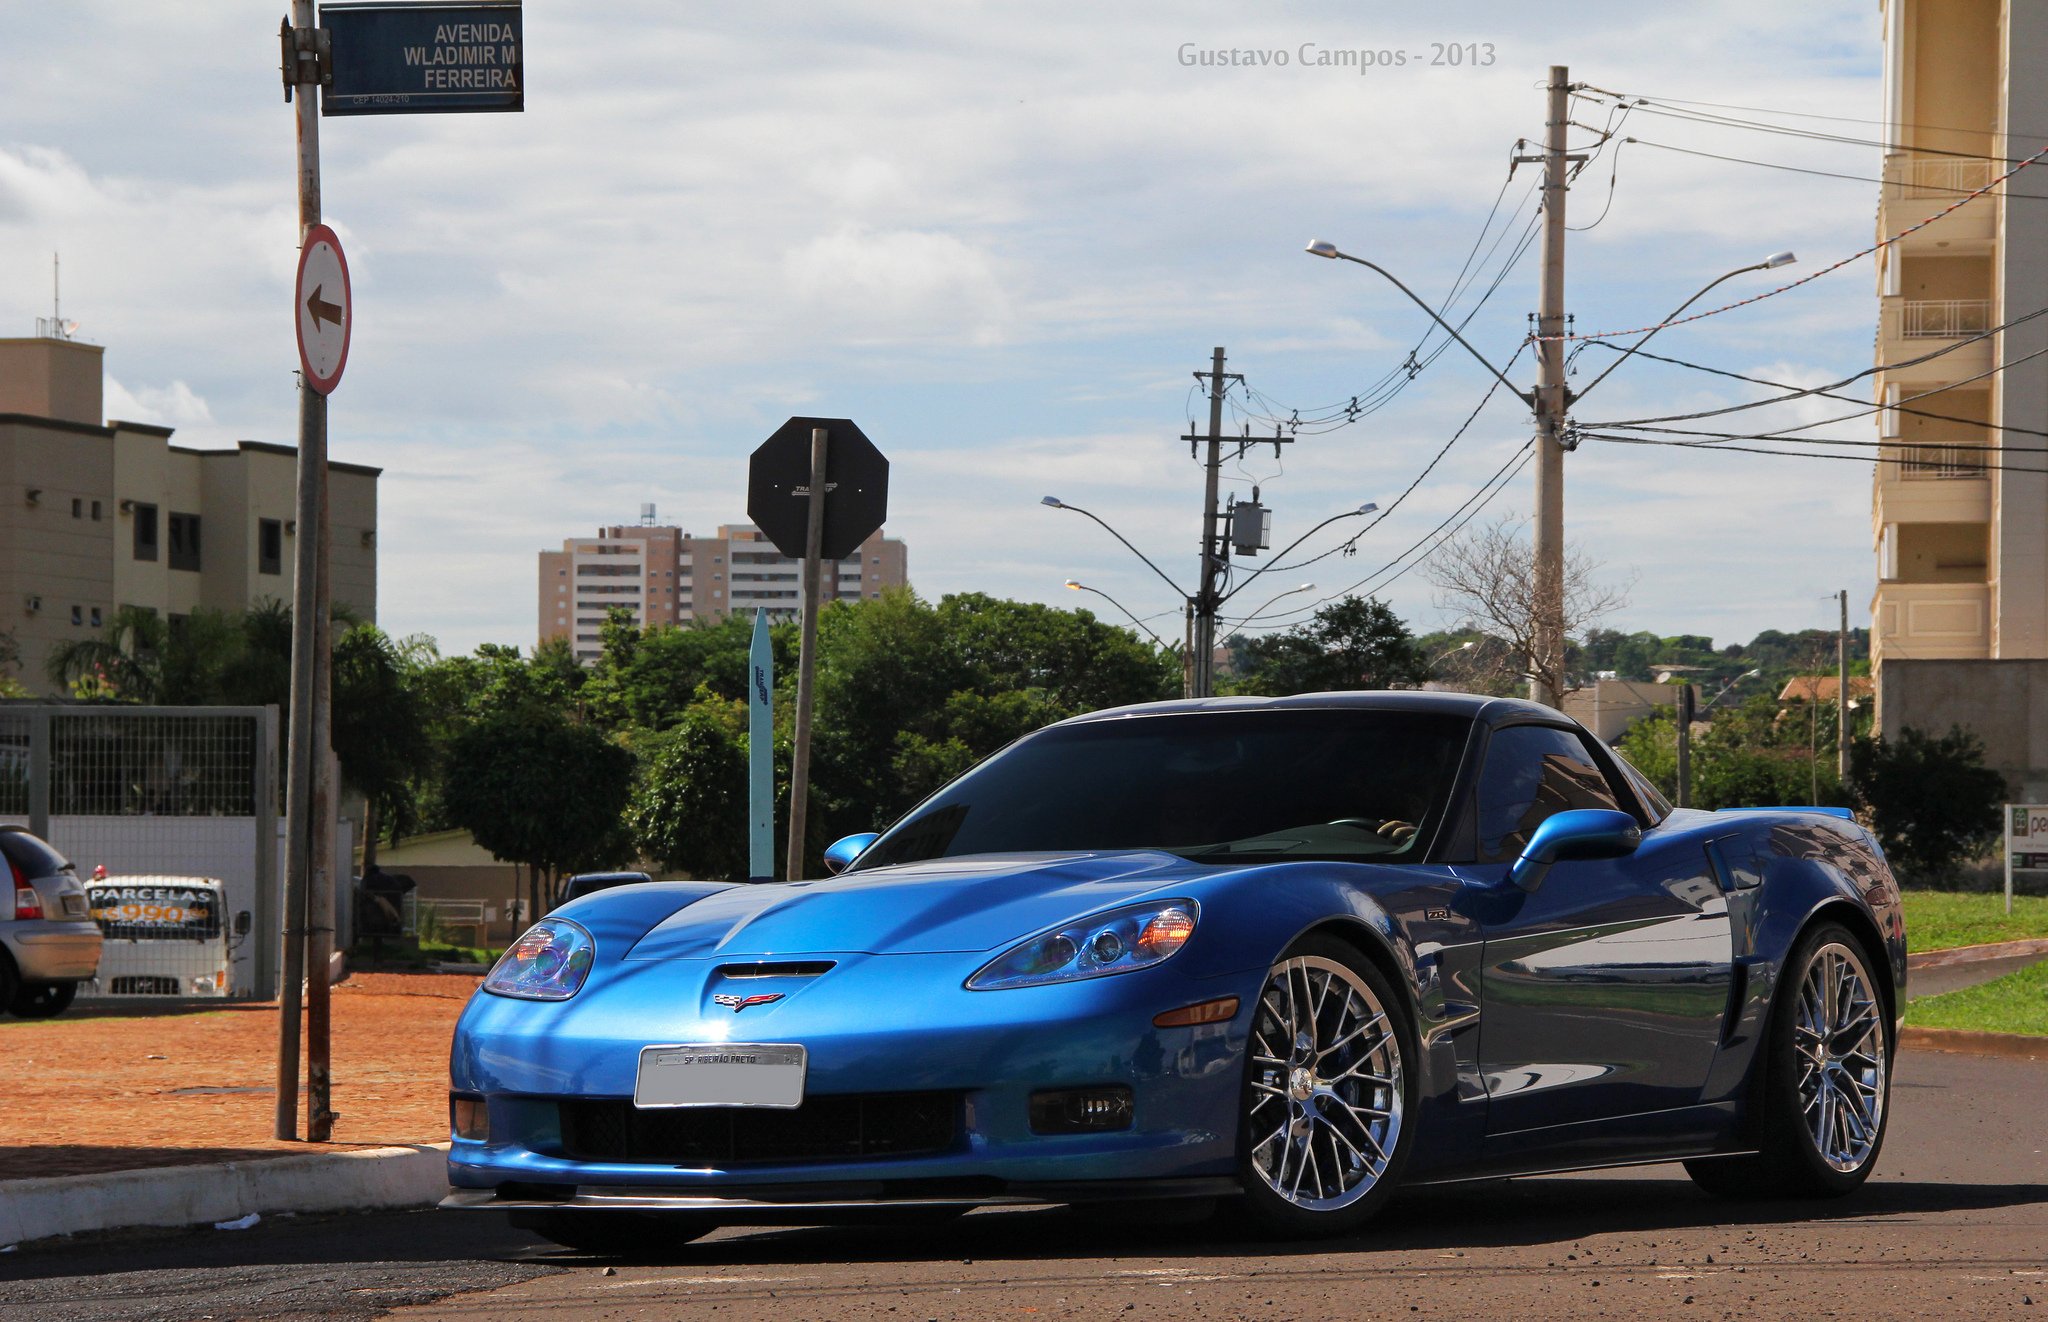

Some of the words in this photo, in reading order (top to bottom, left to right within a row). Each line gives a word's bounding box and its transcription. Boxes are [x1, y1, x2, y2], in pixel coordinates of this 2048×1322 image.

[434, 23, 515, 44] AVENIDA
[404, 46, 495, 66] WLADIMIR
[502, 46, 516, 64] M
[424, 69, 517, 89] FERREIRA
[353, 95, 369, 105] CEP
[91, 888, 210, 902] PARCELAS
[730, 1055, 756, 1064] PRETO
